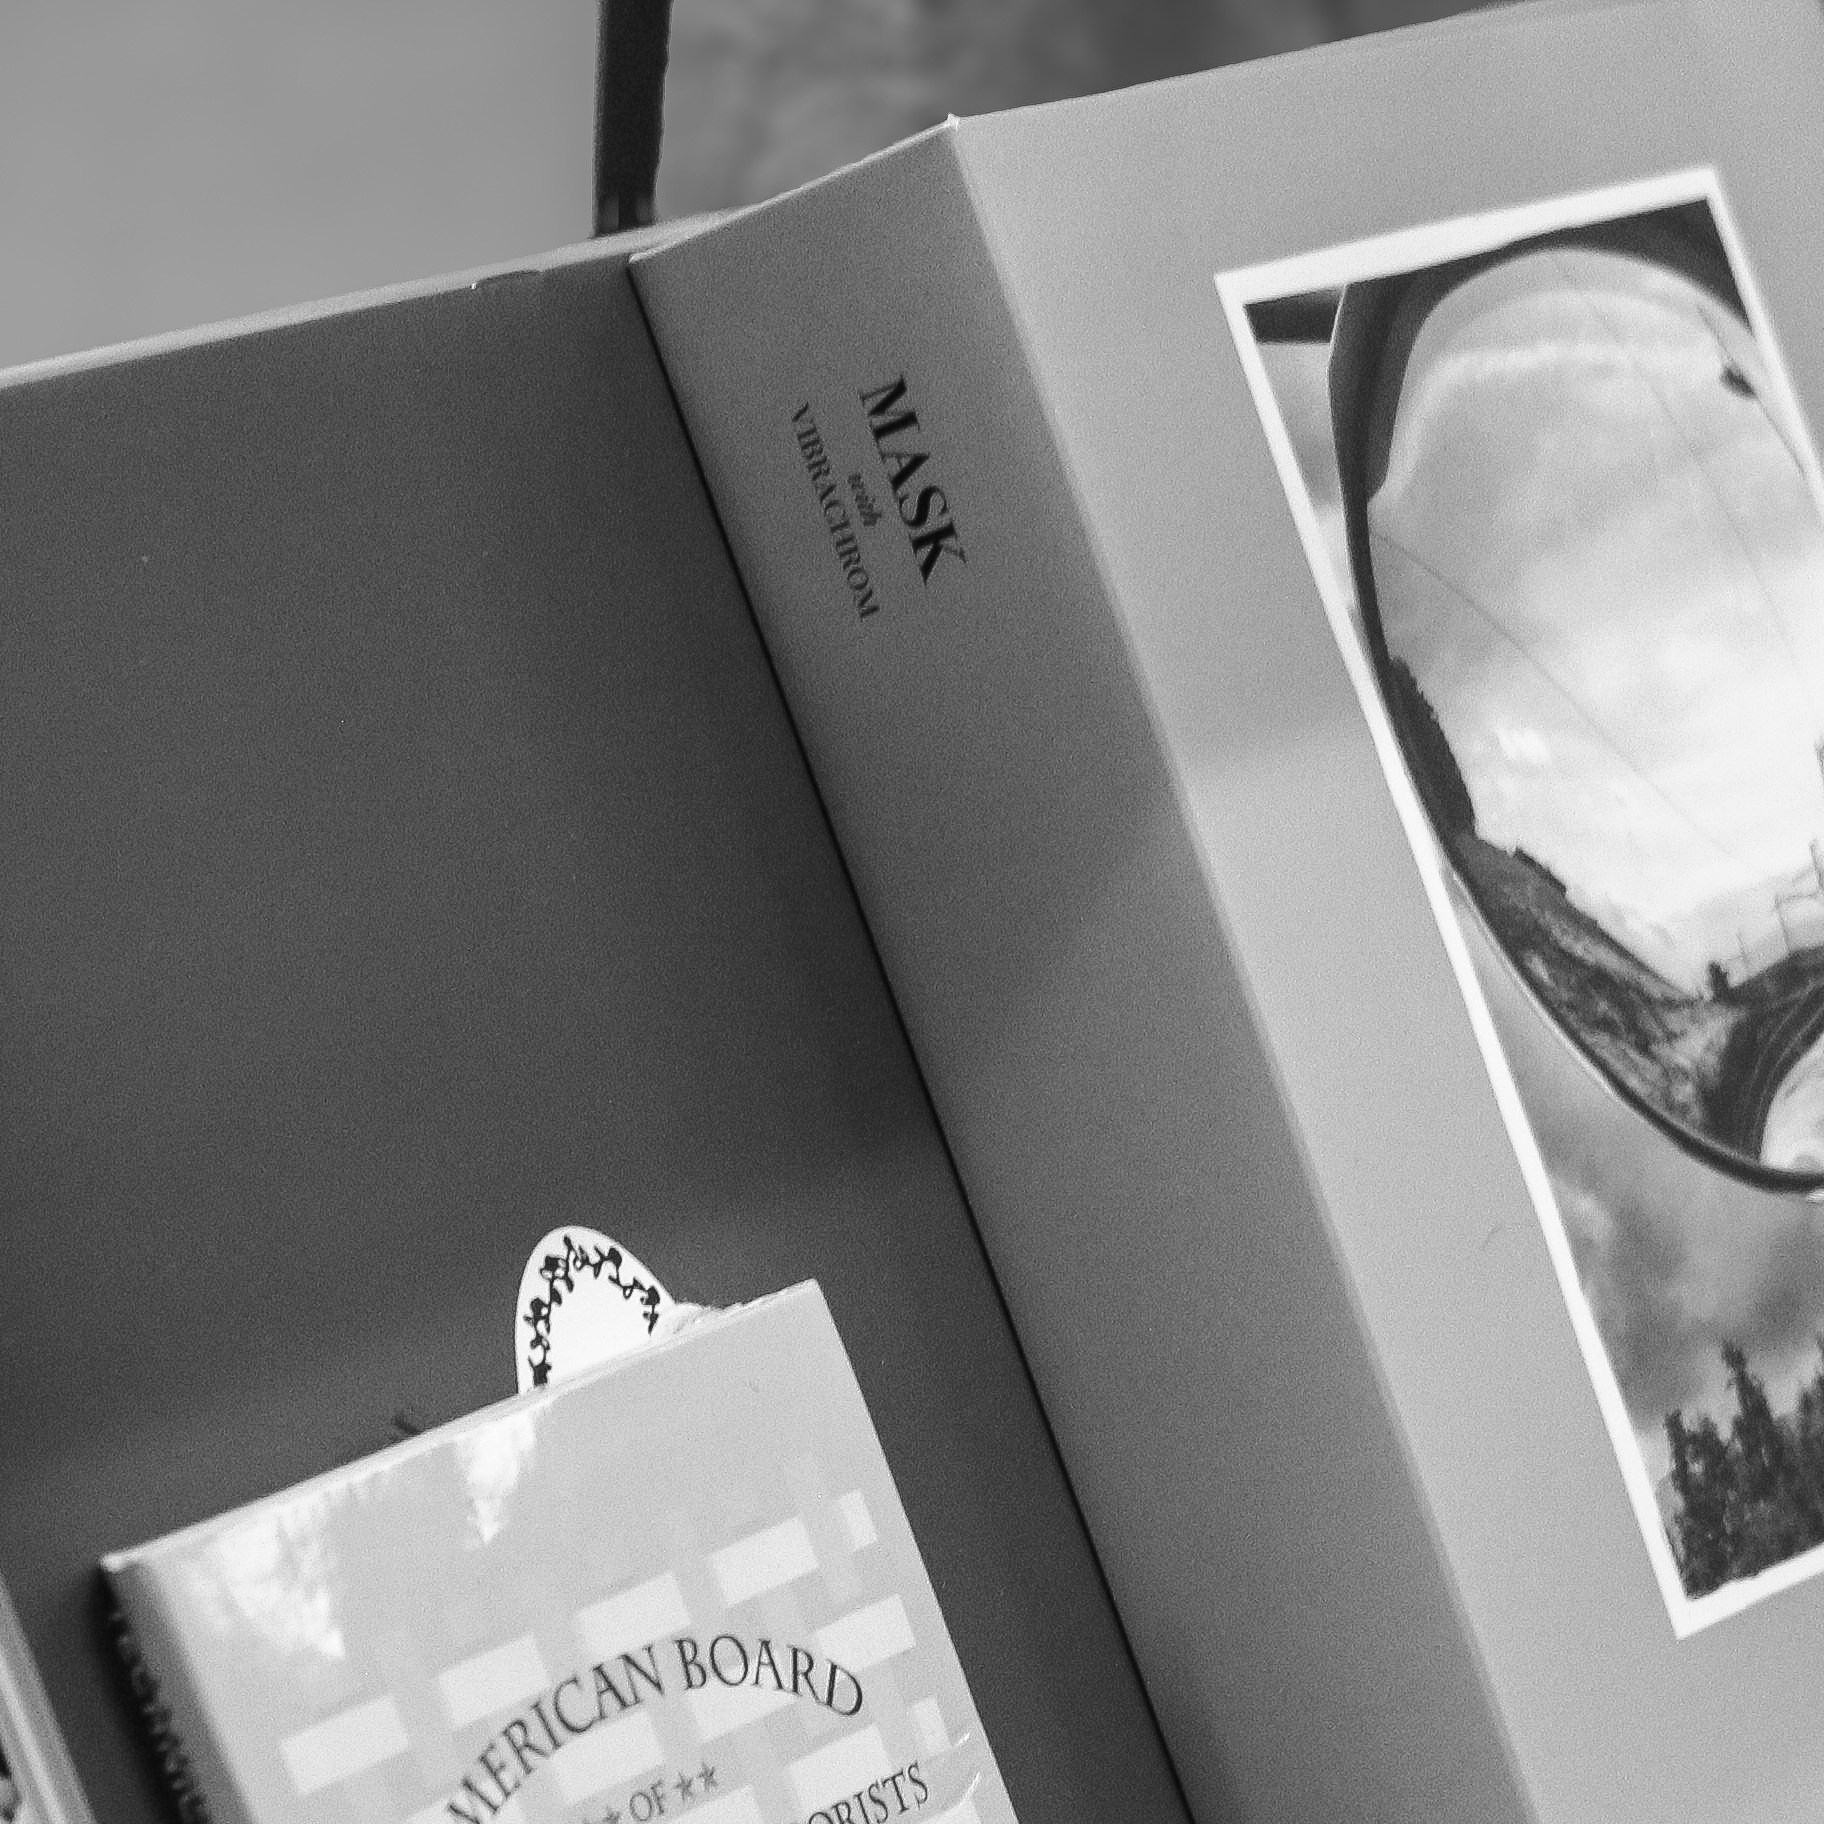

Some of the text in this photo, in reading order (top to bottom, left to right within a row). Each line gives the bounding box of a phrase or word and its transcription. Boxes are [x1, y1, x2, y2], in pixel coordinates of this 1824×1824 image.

[791, 402, 880, 622] VIBRACHROM
[859, 373, 968, 587] MASK
[675, 1635, 863, 1718] BOARD
[628, 1779, 671, 1824] OF
